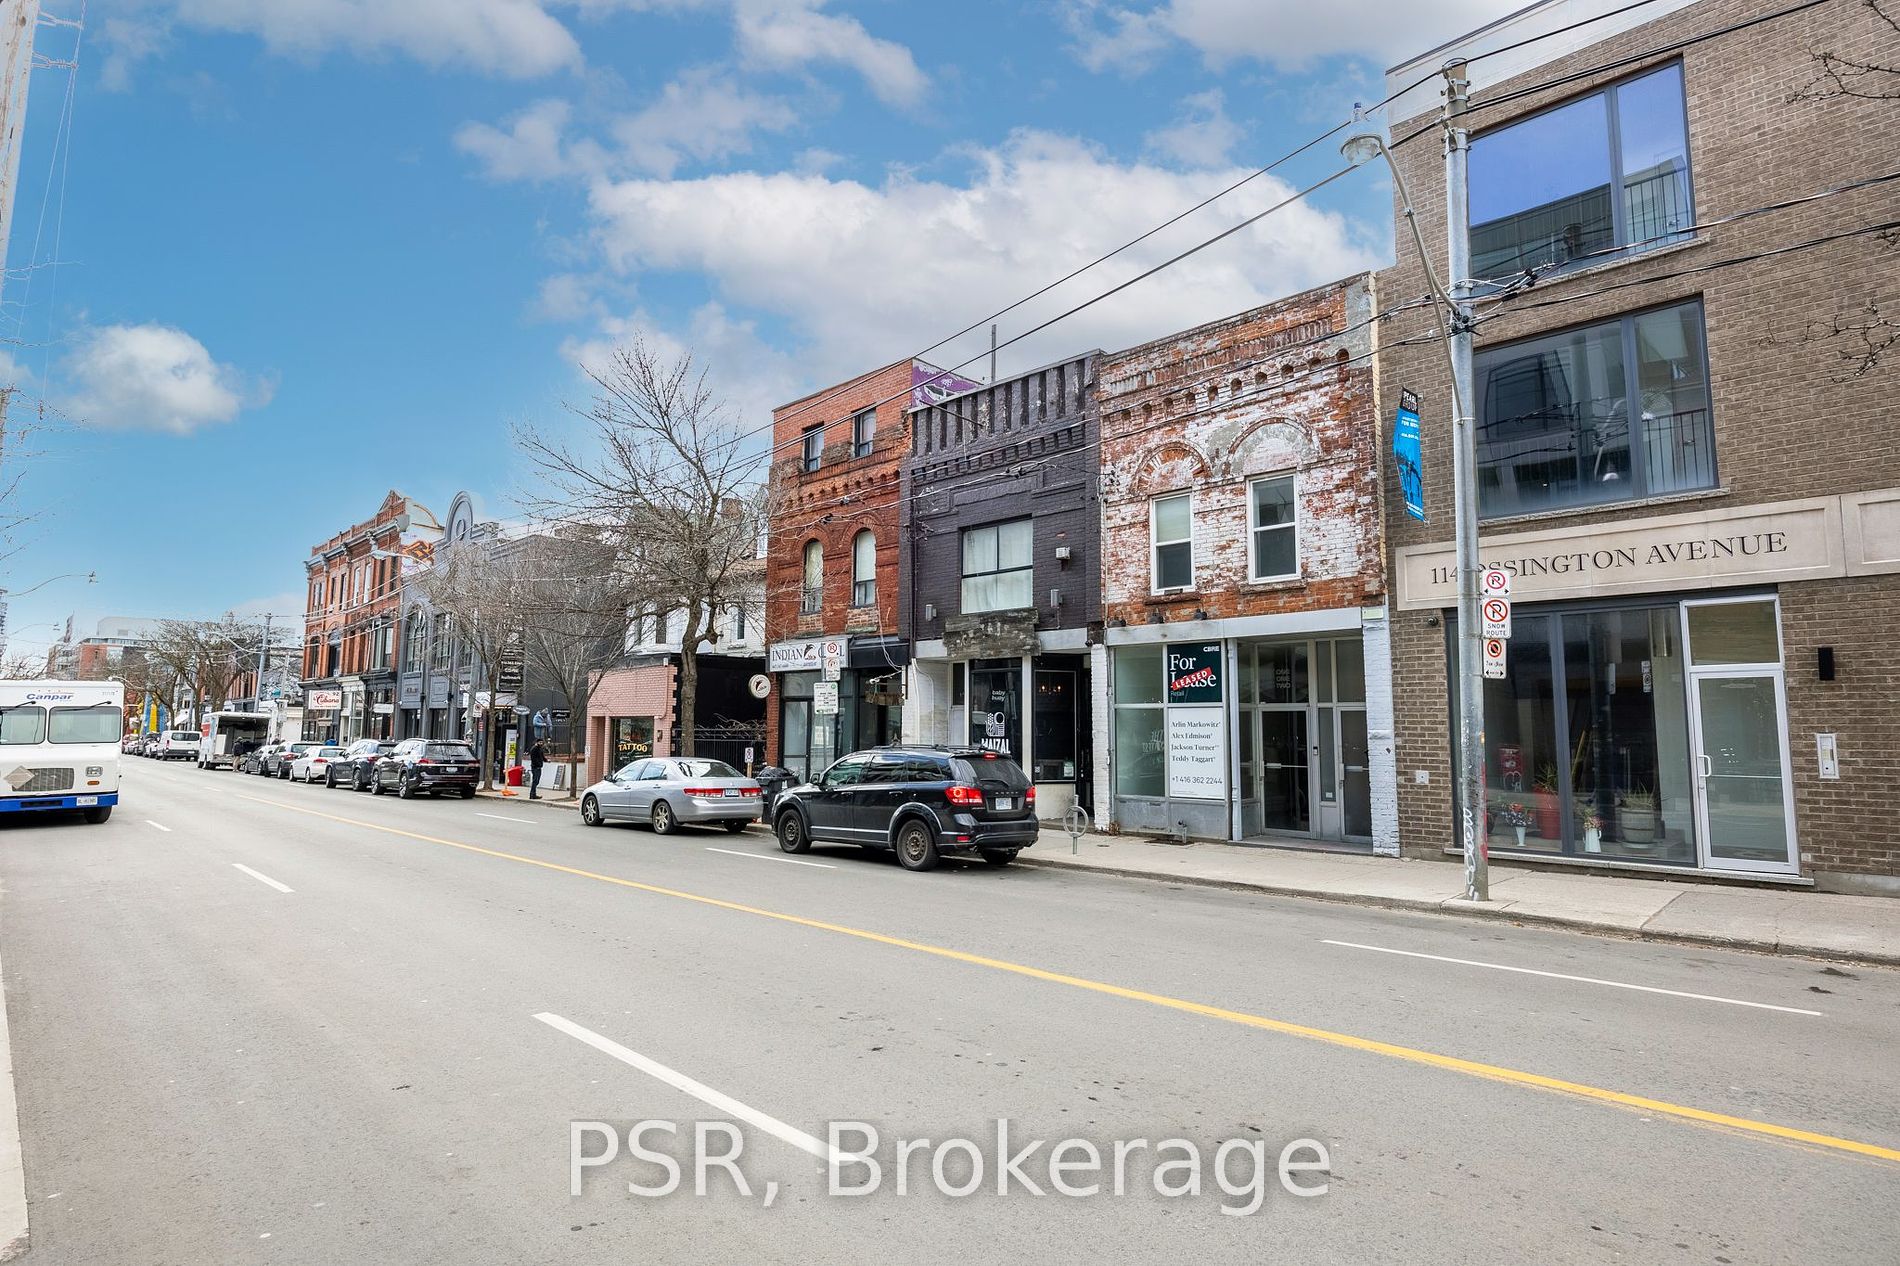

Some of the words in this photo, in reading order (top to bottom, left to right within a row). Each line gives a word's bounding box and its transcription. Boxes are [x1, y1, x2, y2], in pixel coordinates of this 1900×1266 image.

[1646, 532, 1787, 565] AVENUE
[772, 648, 803, 661] INDIAN
[1169, 654, 1196, 670] For
[1175, 670, 1207, 688] LEASED
[618, 743, 648, 752] TATTOO
[981, 739, 1011, 754] MAIZAL
